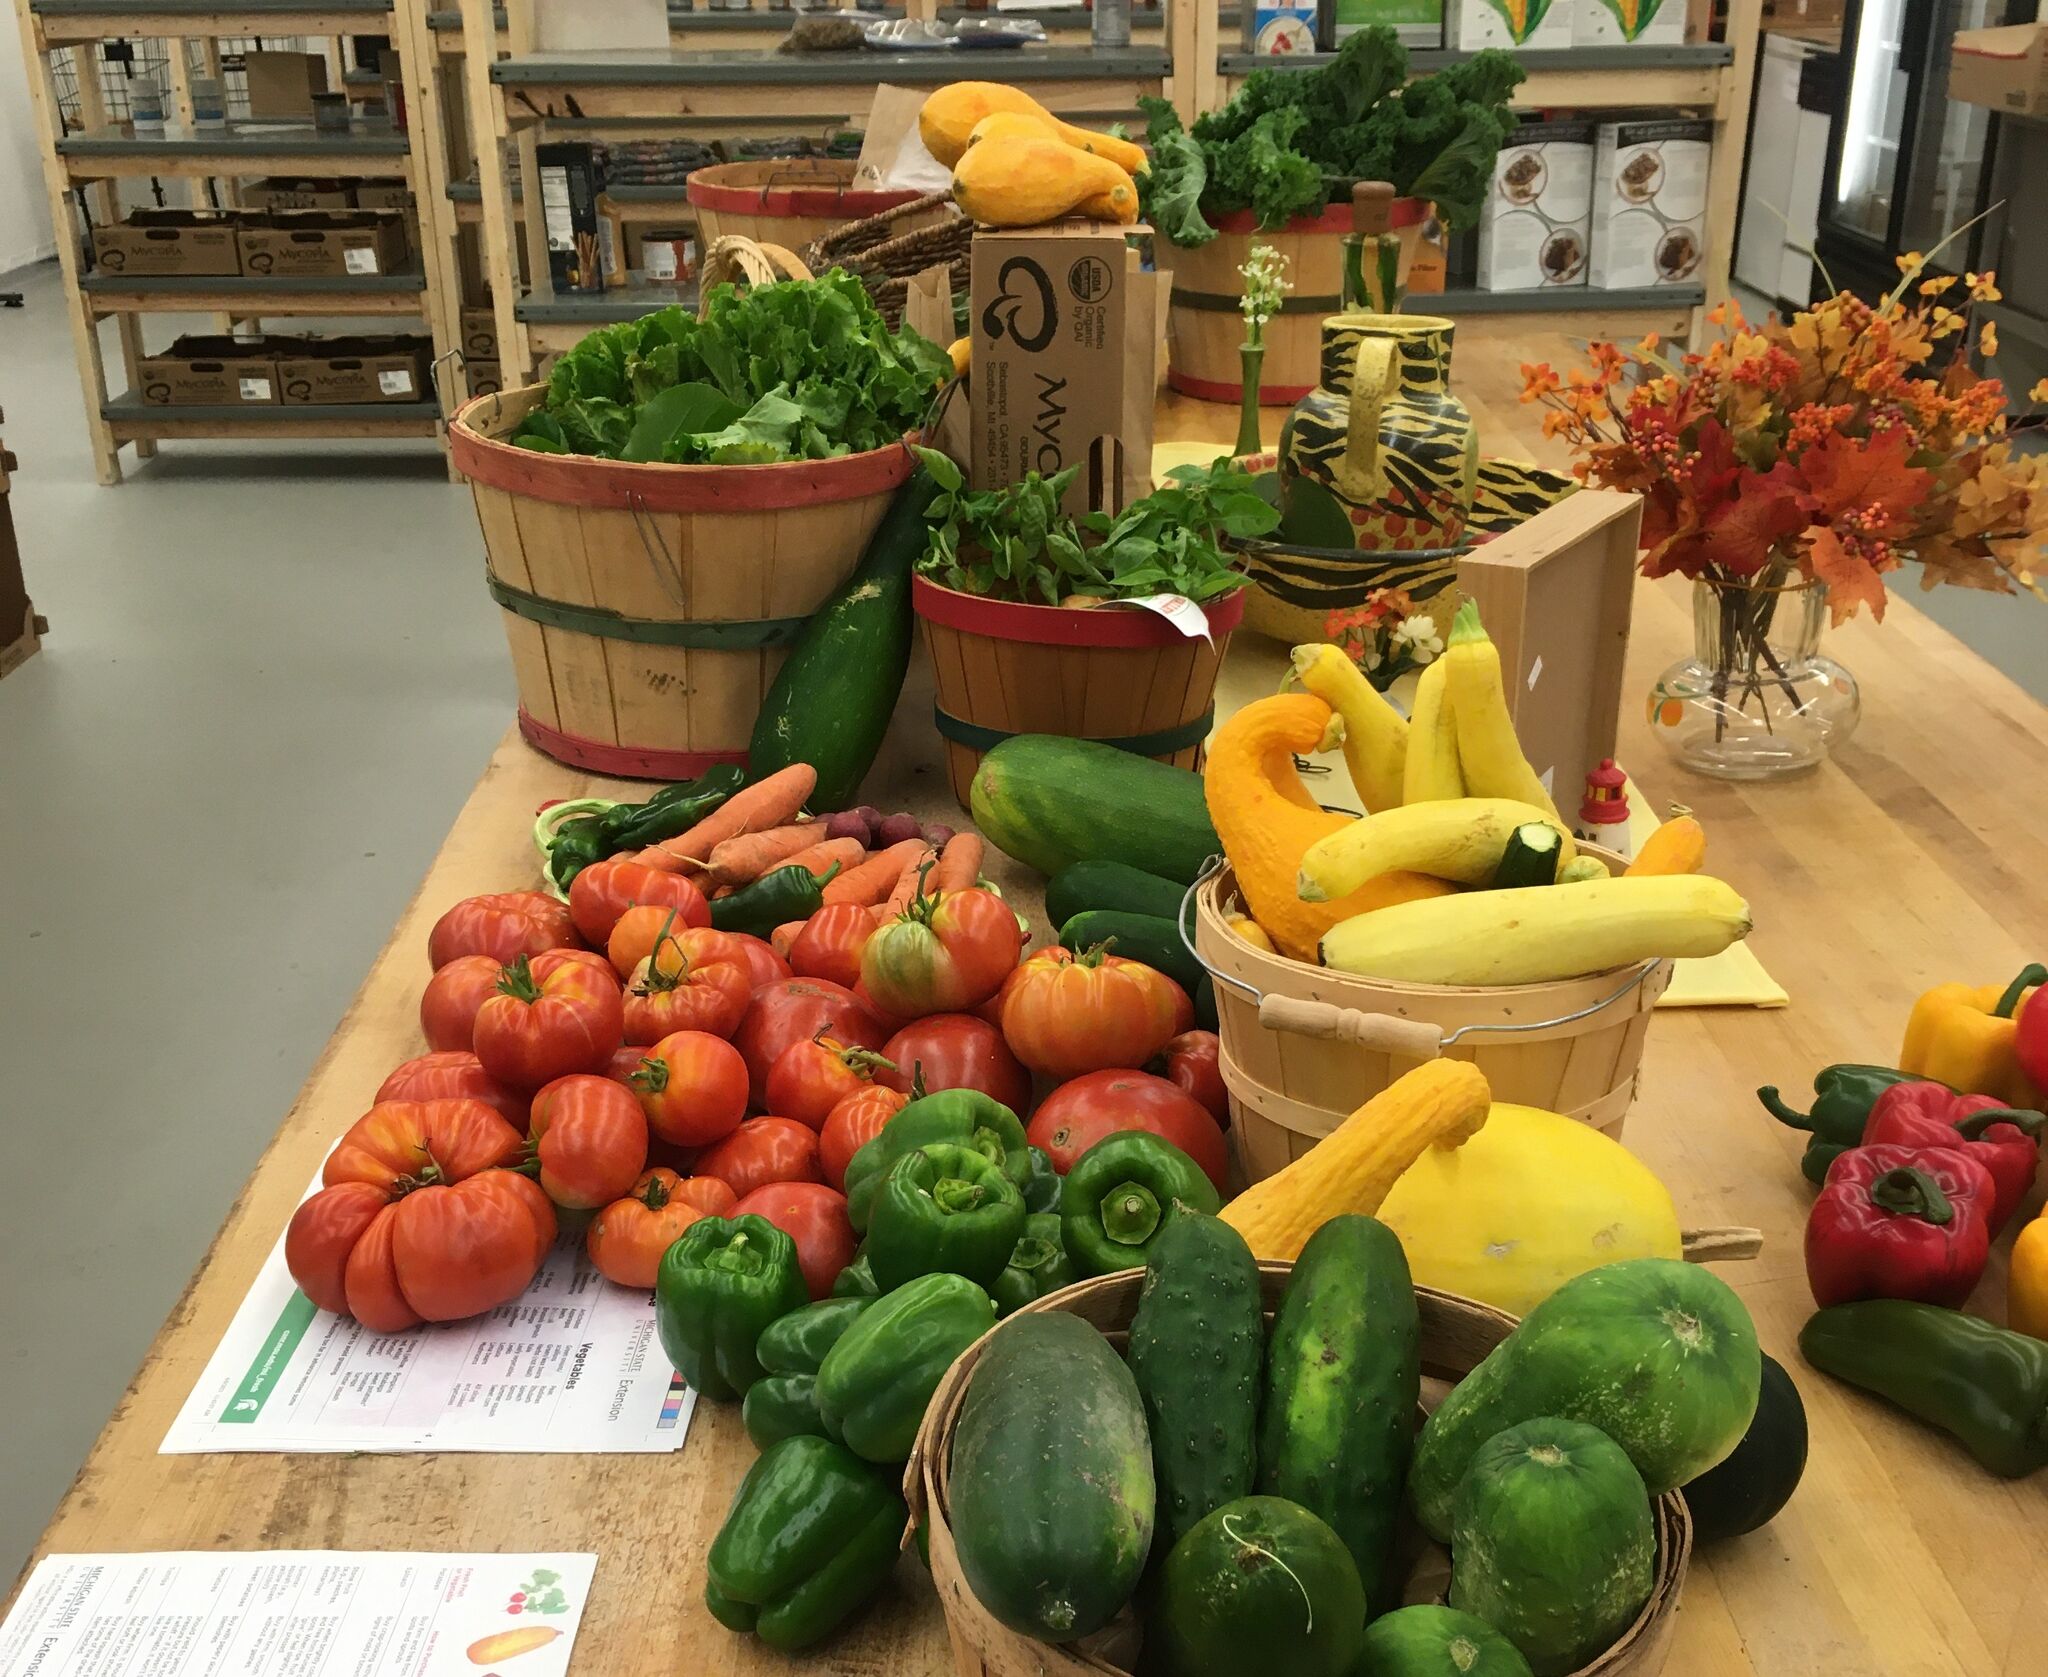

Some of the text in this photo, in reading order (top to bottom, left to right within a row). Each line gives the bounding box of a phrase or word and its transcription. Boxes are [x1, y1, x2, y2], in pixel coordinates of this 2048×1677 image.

[1092, 267, 1102, 292] USDA
[1072, 306, 1083, 343] by QAI
[1083, 305, 1095, 348] Organic
[1096, 305, 1106, 350] Certified
[999, 424, 1008, 439] CA
[619, 1319, 643, 1372] UNIVERSITY
[637, 1319, 656, 1351] MICHIGAN
[563, 1342, 593, 1389] Vegetables
[630, 1354, 645, 1371] STATE
[606, 1379, 633, 1420] Extension
[47, 1566, 90, 1628] UNIVERSITY
[59, 1566, 104, 1627] MICHIGAN STATE
